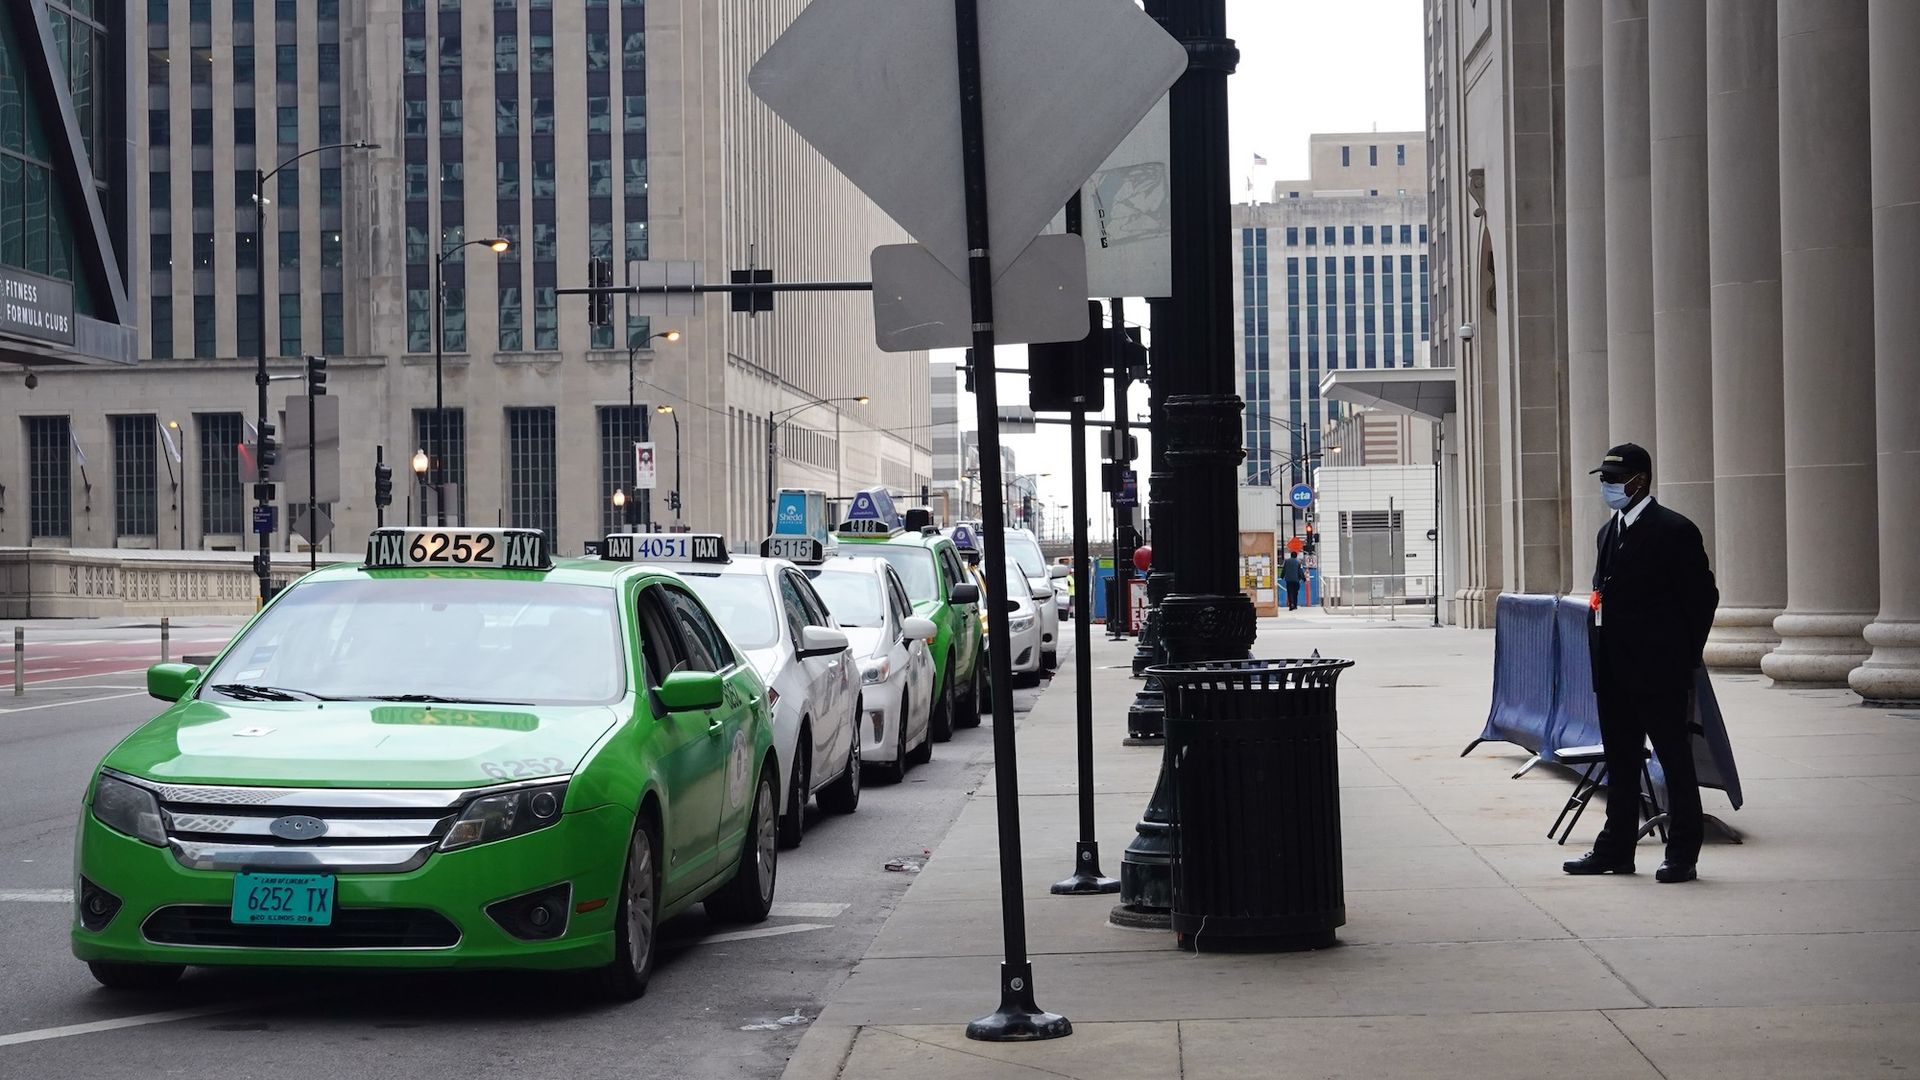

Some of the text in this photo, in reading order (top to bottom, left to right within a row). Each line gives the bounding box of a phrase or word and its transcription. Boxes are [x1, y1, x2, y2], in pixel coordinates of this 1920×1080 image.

[6, 279, 37, 303] FITNESS
[7, 304, 69, 333] FORMULA CLUBS
[1293, 491, 1311, 500] cta
[779, 513, 803, 521] Shedd
[853, 520, 874, 532] 418
[369, 533, 540, 567] TAXI 6252 TAXI
[607, 538, 718, 558] TAXI 4051 TAXI
[774, 540, 808, 557] 5115
[480, 757, 573, 780] 6252
[248, 886, 328, 912] 6252 TX
